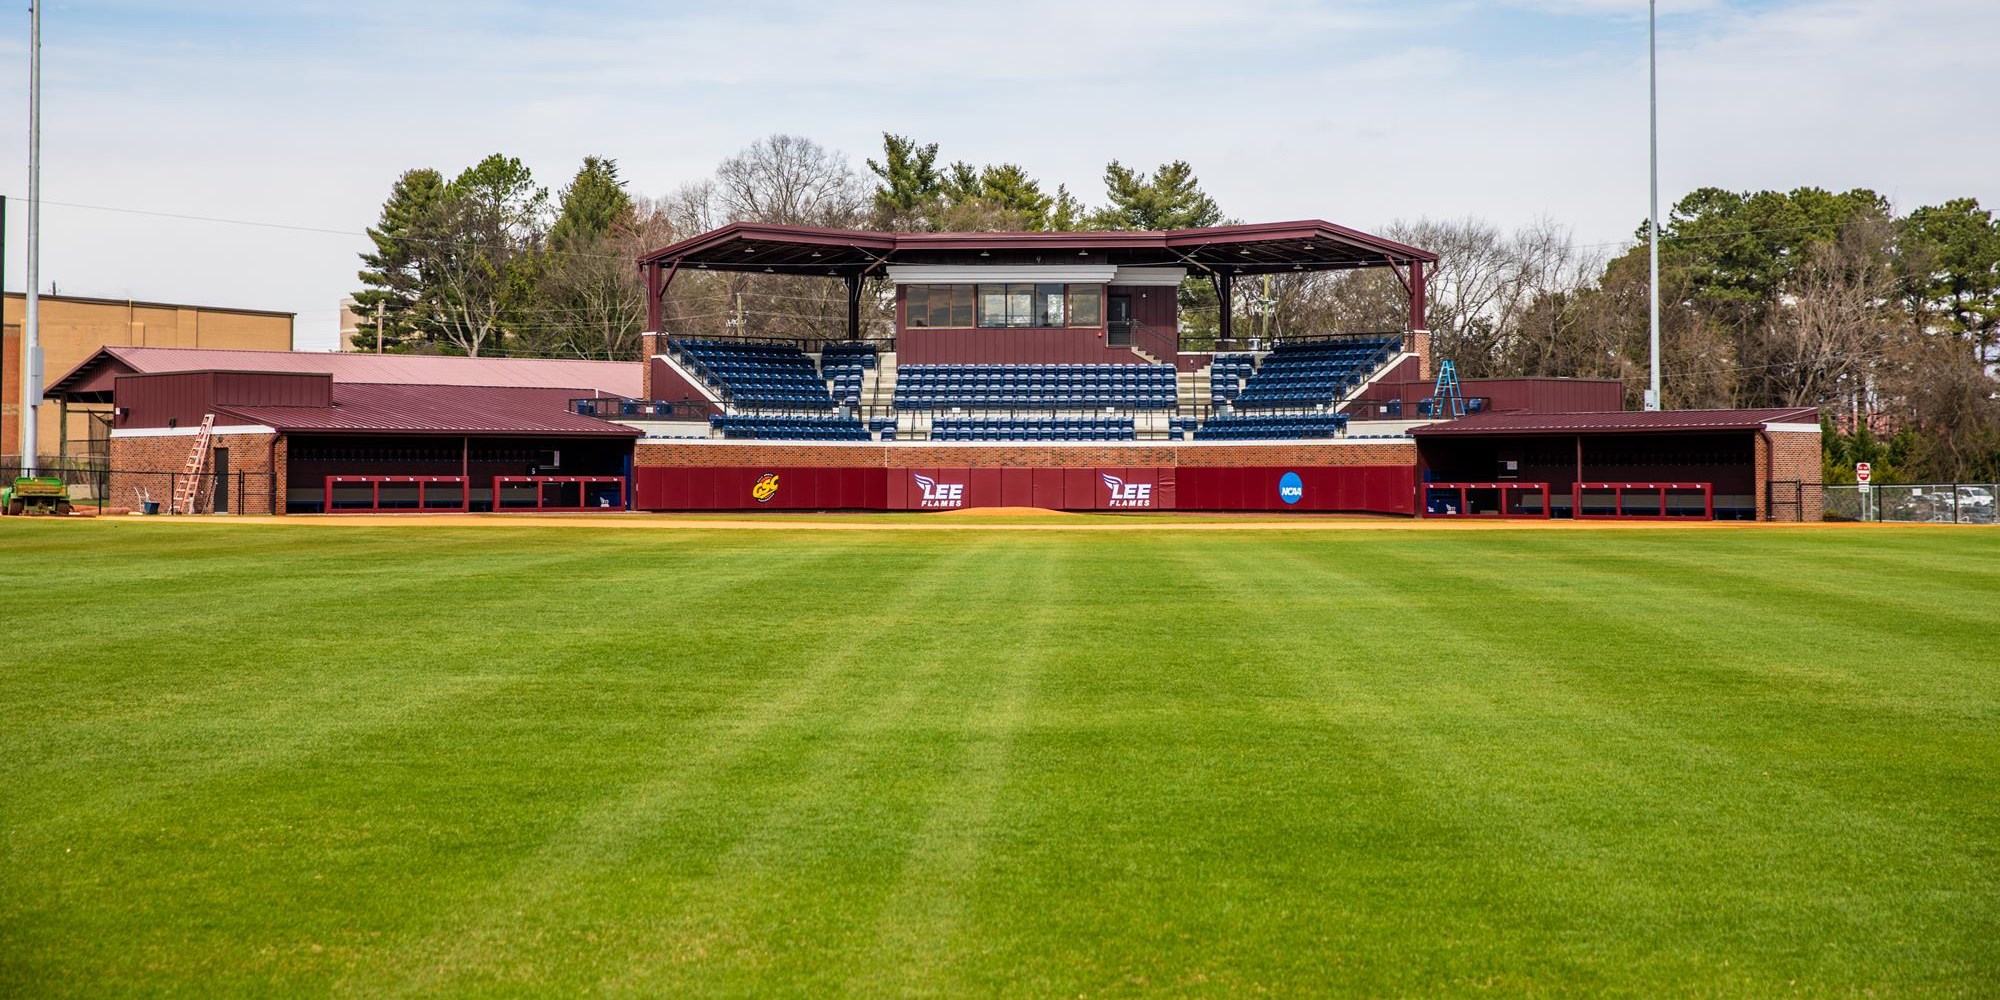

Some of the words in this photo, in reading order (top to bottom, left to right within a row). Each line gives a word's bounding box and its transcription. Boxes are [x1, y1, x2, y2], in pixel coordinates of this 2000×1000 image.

[923, 484, 964, 499] LEE
[1111, 483, 1152, 499] LEE
[1281, 487, 1303, 496] NCAA
[1109, 499, 1150, 507] FLAMES
